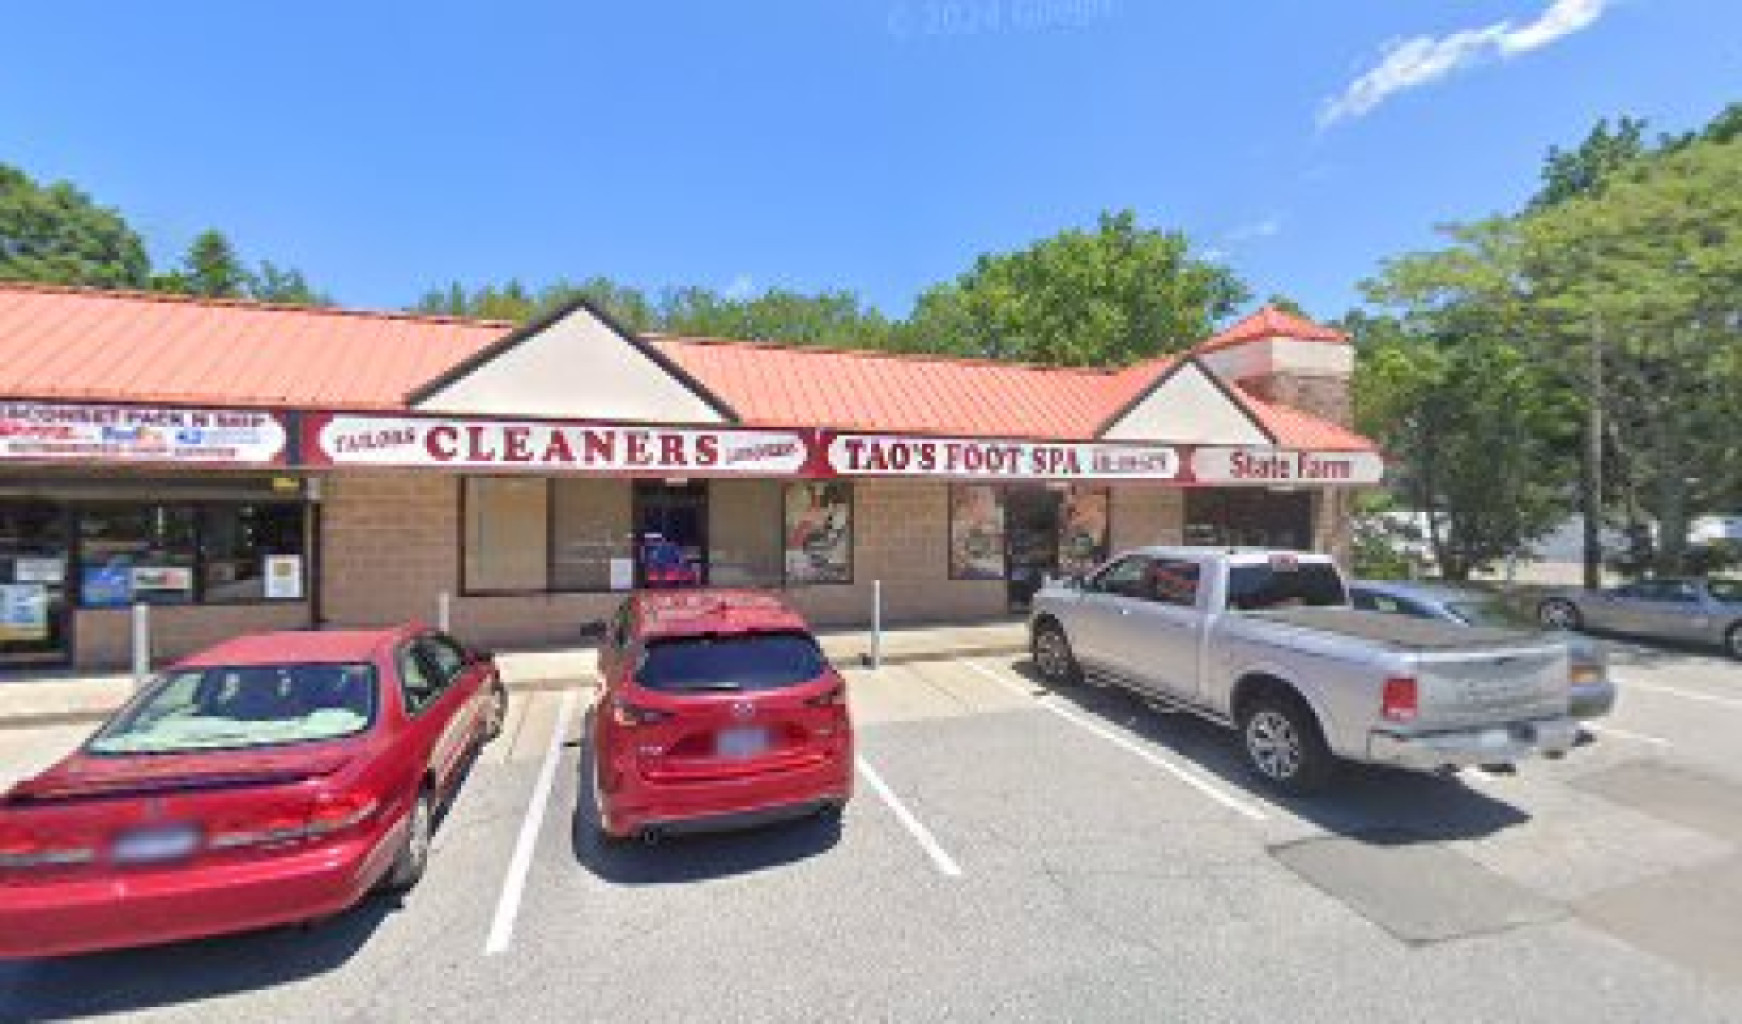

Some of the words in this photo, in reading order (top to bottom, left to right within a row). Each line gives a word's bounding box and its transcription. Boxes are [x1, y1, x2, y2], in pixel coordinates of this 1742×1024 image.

[425, 425, 720, 466] CLEANERS
[844, 438, 938, 471] TAO'S
[944, 443, 1022, 474] FOOT
[1031, 446, 1082, 475] SPA
[1229, 450, 1292, 479] State
